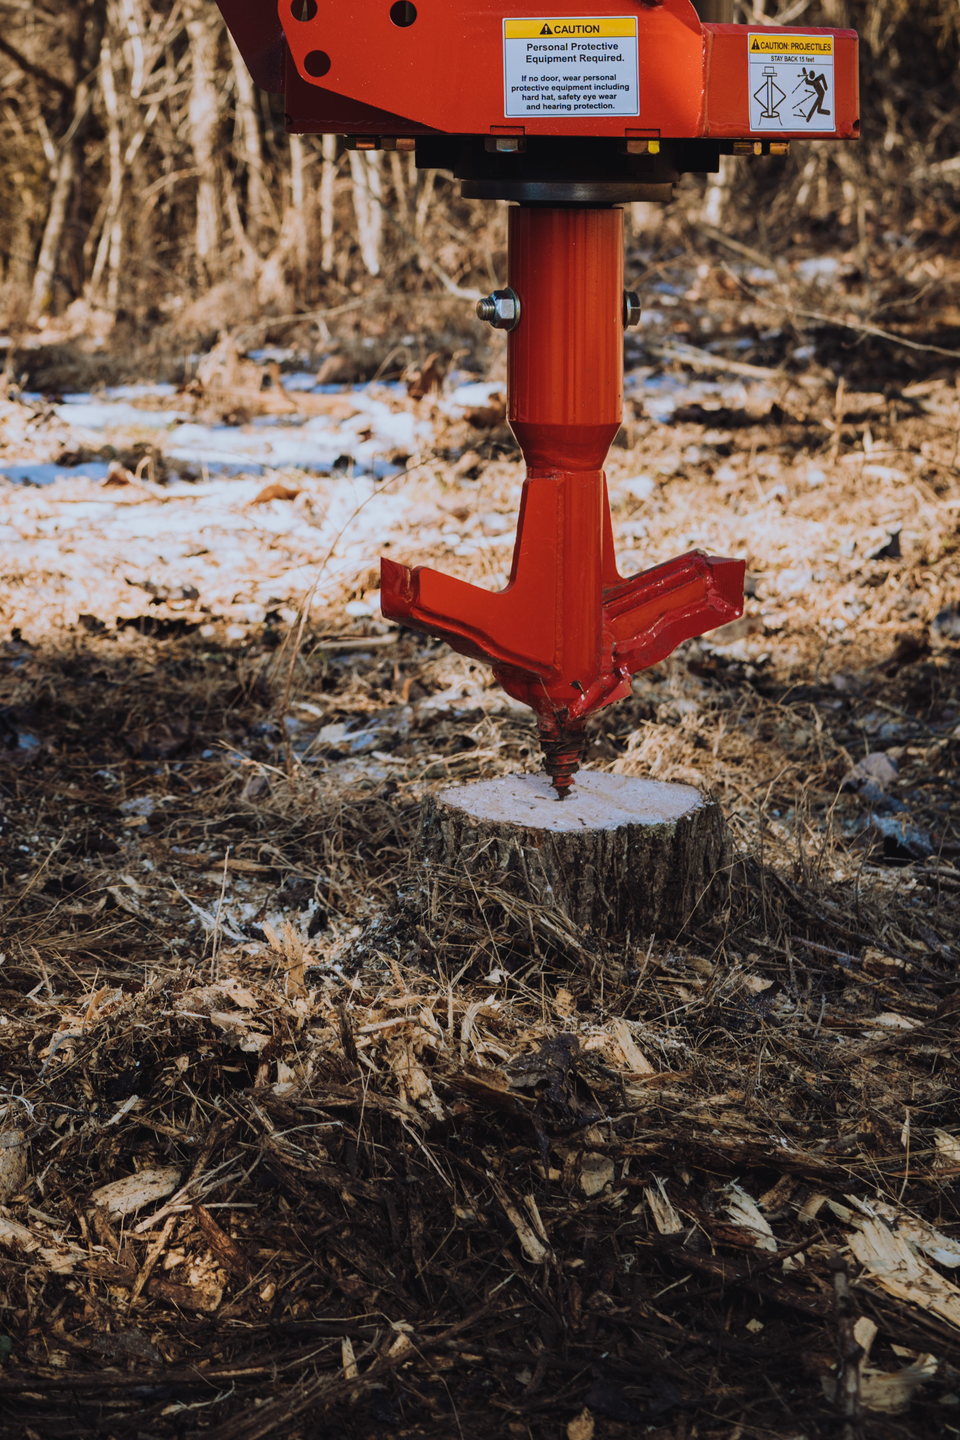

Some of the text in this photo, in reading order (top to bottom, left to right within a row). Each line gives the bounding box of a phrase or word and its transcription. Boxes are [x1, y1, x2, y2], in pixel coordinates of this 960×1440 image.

[554, 25, 600, 34] CAUTION
[526, 42, 618, 51] Personal Protective
[790, 42, 831, 51] PROJECTILES
[526, 54, 624, 64] Equipment Required.
[583, 74, 616, 82] personal
[511, 84, 549, 92] protective
[551, 84, 592, 92] equipment
[542, 103, 572, 111] hearing
